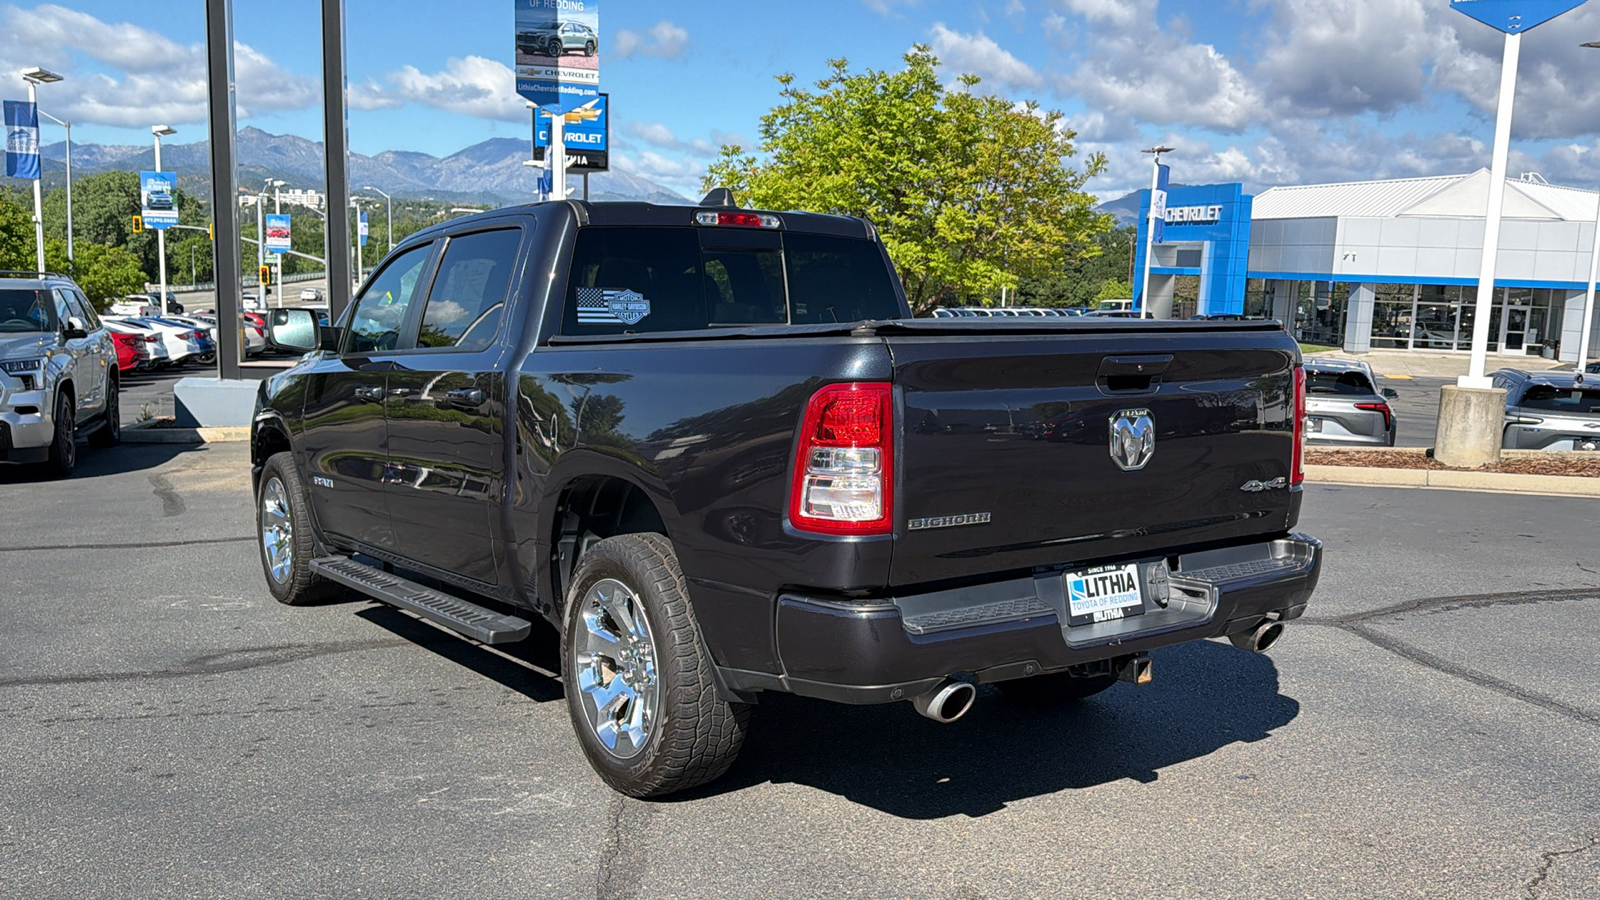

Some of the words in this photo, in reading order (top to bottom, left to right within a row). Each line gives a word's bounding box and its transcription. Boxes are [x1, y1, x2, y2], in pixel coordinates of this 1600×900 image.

[544, 0, 584, 11] REDDING
[545, 69, 596, 79] CHEVROLET
[517, 83, 597, 96] LithiaChevroletRedding.com
[539, 130, 602, 144] CROLET
[1165, 205, 1223, 222] CHEVROLET
[908, 512, 991, 530] BIGHORN
[1087, 566, 1104, 574] SINCE
[1085, 572, 1137, 598] LITHIA
[1072, 600, 1098, 611] TOYOTA
[1099, 598, 1108, 606] OF
[1109, 592, 1139, 605] REDDING
[1101, 607, 1125, 620] LITHIA
